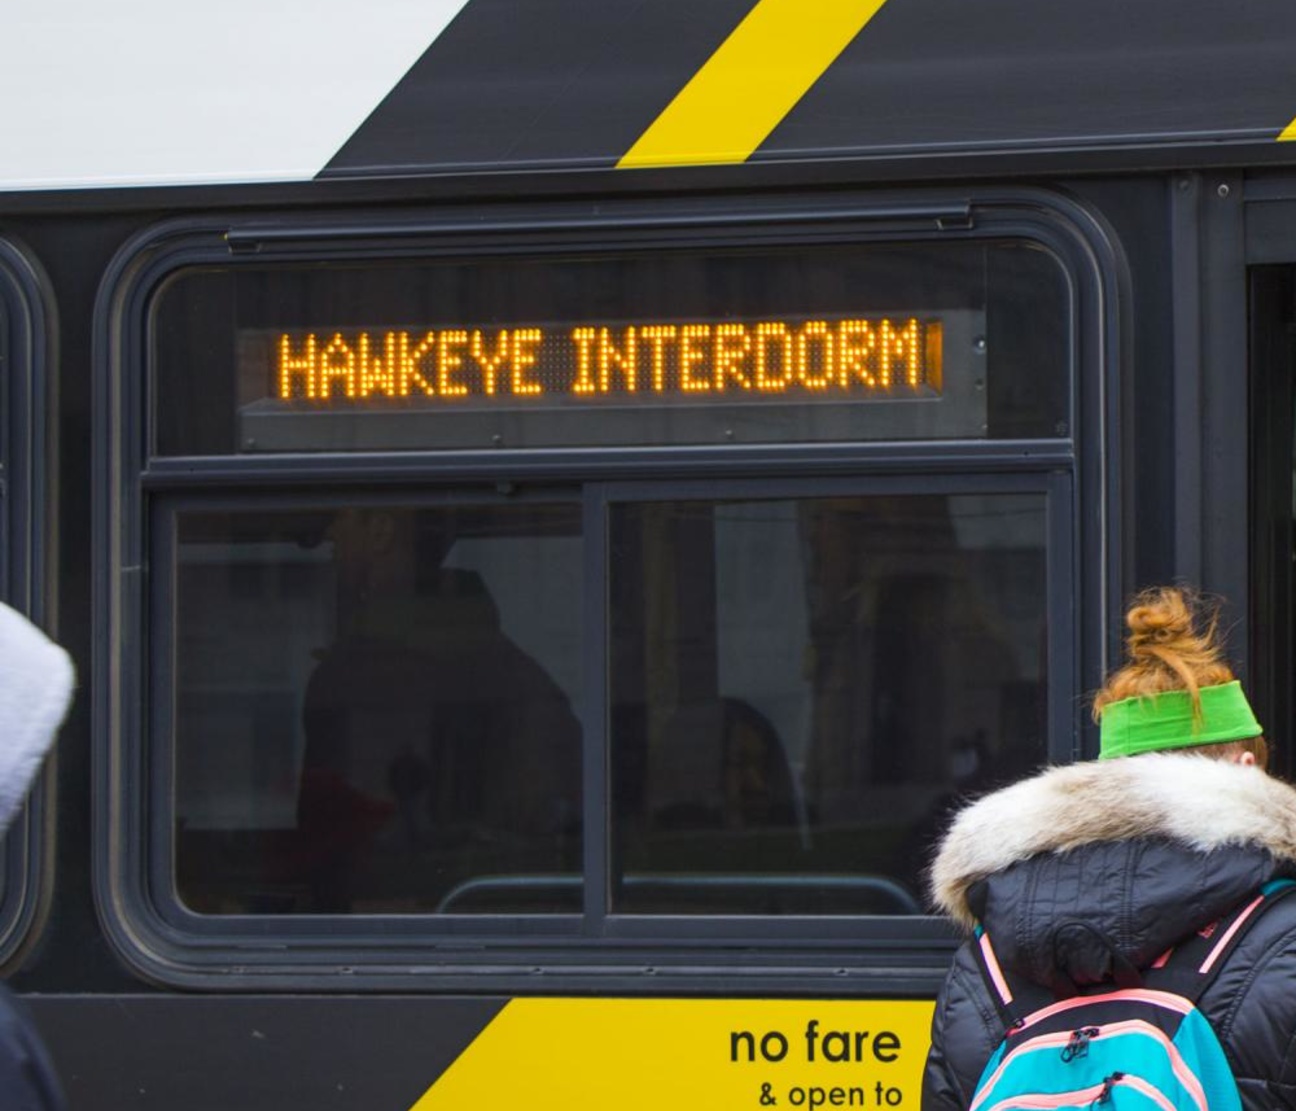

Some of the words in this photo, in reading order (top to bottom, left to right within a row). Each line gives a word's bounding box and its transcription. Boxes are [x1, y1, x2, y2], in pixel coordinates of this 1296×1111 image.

[279, 328, 542, 399] HAWKEYE
[572, 319, 918, 393] INTERDORM
[730, 1030, 789, 1062] no
[805, 1019, 902, 1062] fare
[759, 1081, 778, 1107] &
[788, 1086, 865, 1111] open
[874, 1081, 903, 1107] to
